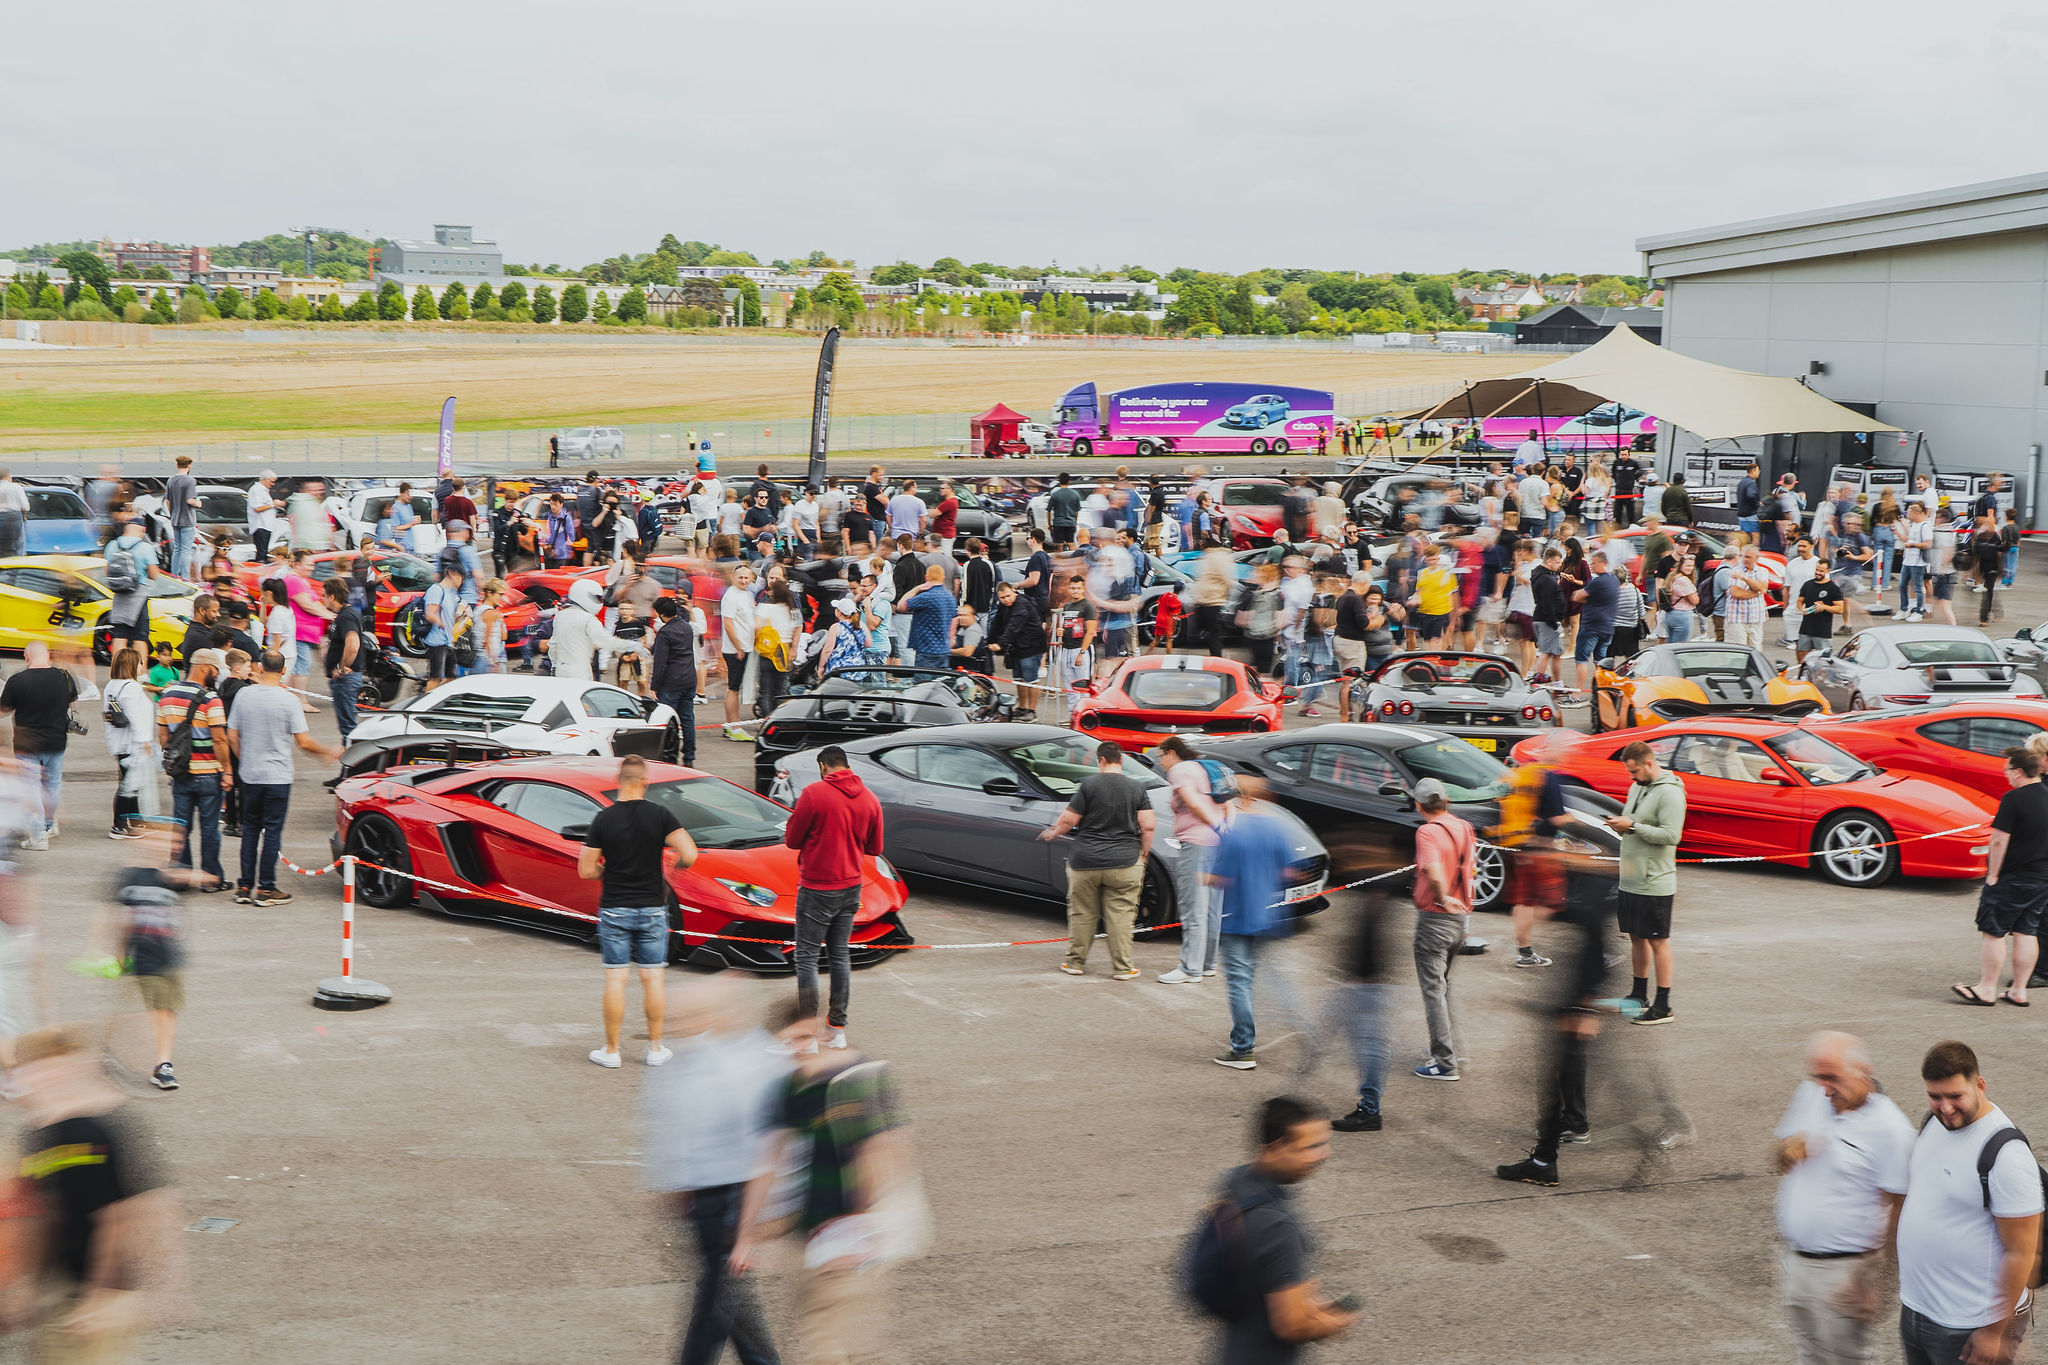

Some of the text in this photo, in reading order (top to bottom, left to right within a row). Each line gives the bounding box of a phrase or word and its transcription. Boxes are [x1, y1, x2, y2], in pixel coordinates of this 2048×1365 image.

[1120, 397, 1168, 408] Delivering
[1169, 399, 1191, 409] your
[1143, 409, 1163, 418] and
[1164, 409, 1181, 418] far
[441, 429, 452, 466] cinch
